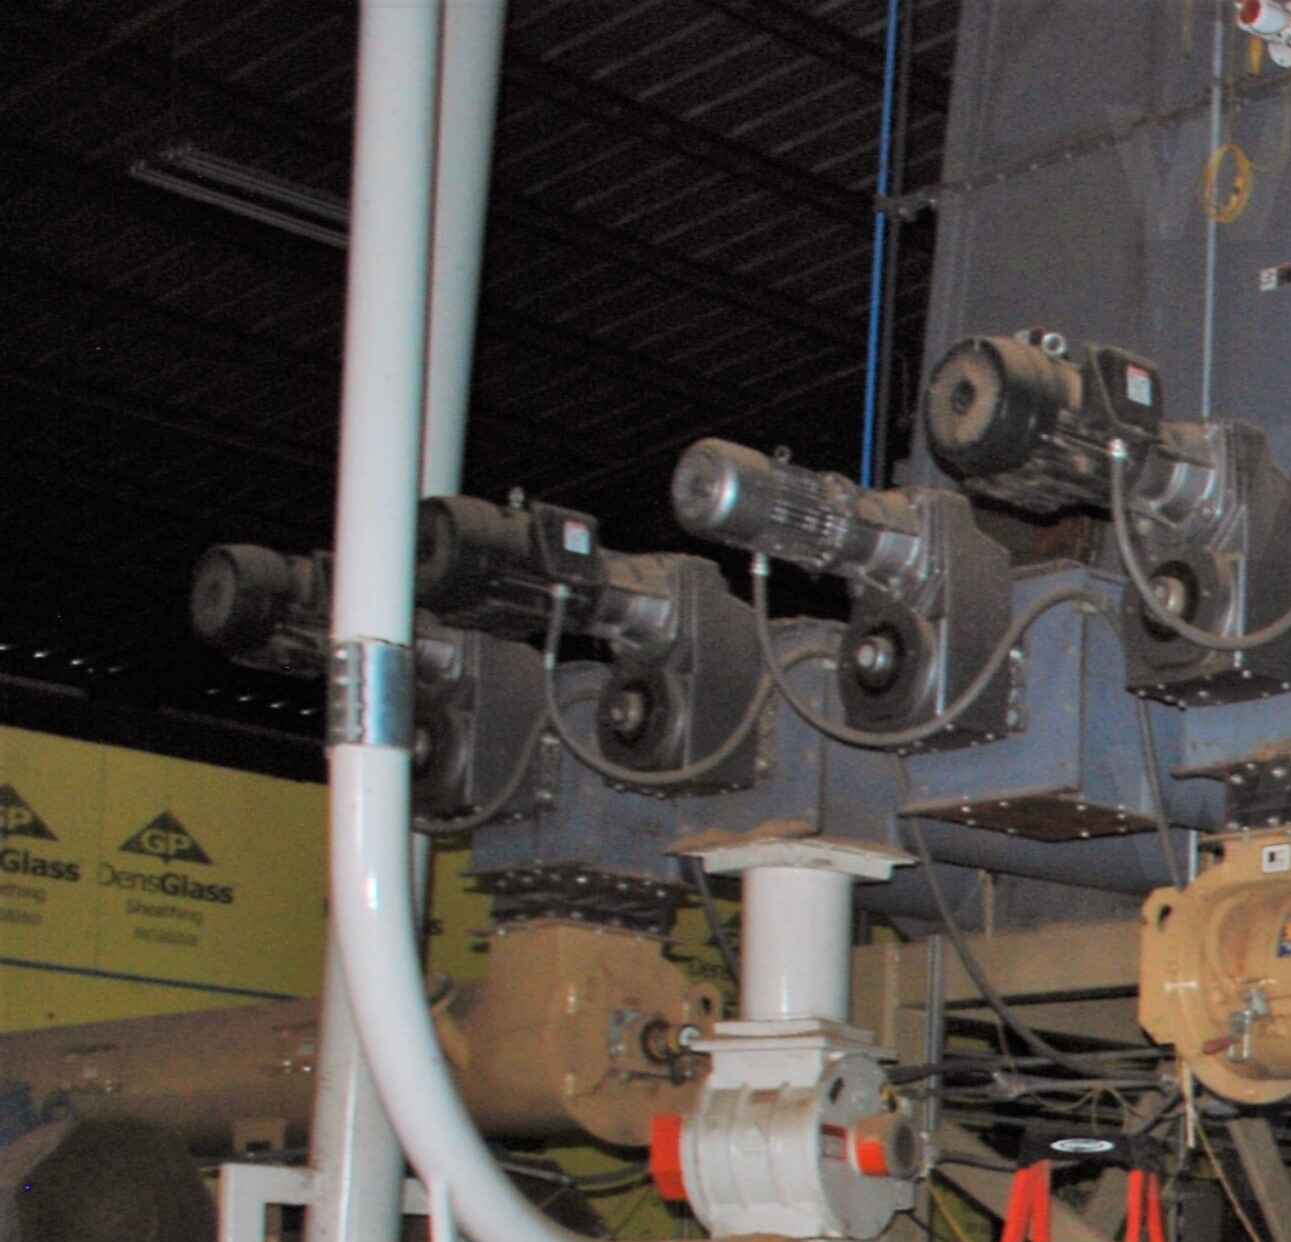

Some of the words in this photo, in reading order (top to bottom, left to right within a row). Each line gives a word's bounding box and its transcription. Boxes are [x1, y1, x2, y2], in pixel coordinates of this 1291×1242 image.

[140, 827, 193, 855] GP
[0, 849, 81, 883] Glass
[98, 861, 234, 905] DensGlass
